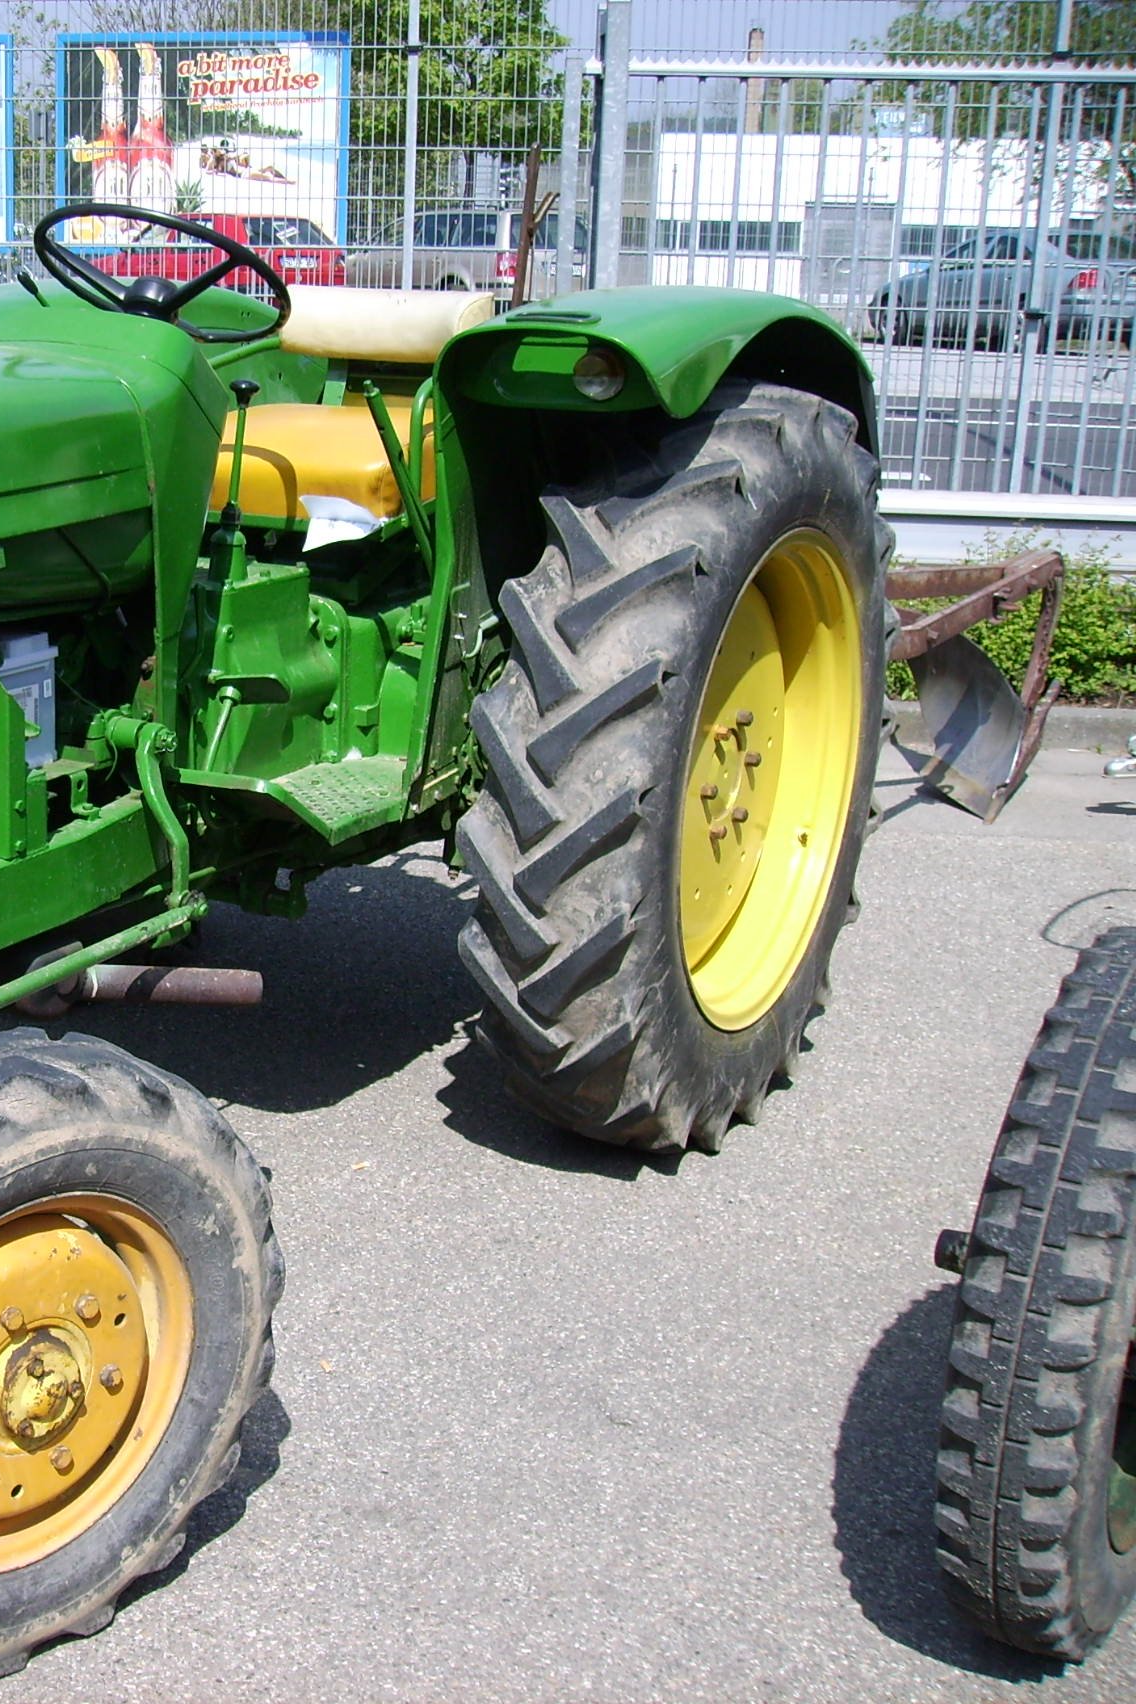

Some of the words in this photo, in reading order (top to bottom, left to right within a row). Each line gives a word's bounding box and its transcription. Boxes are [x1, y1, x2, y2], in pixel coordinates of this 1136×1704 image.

[178, 60, 194, 75] a
[198, 53, 226, 74] bit
[231, 54, 290, 71] more
[189, 67, 320, 103] paradise
